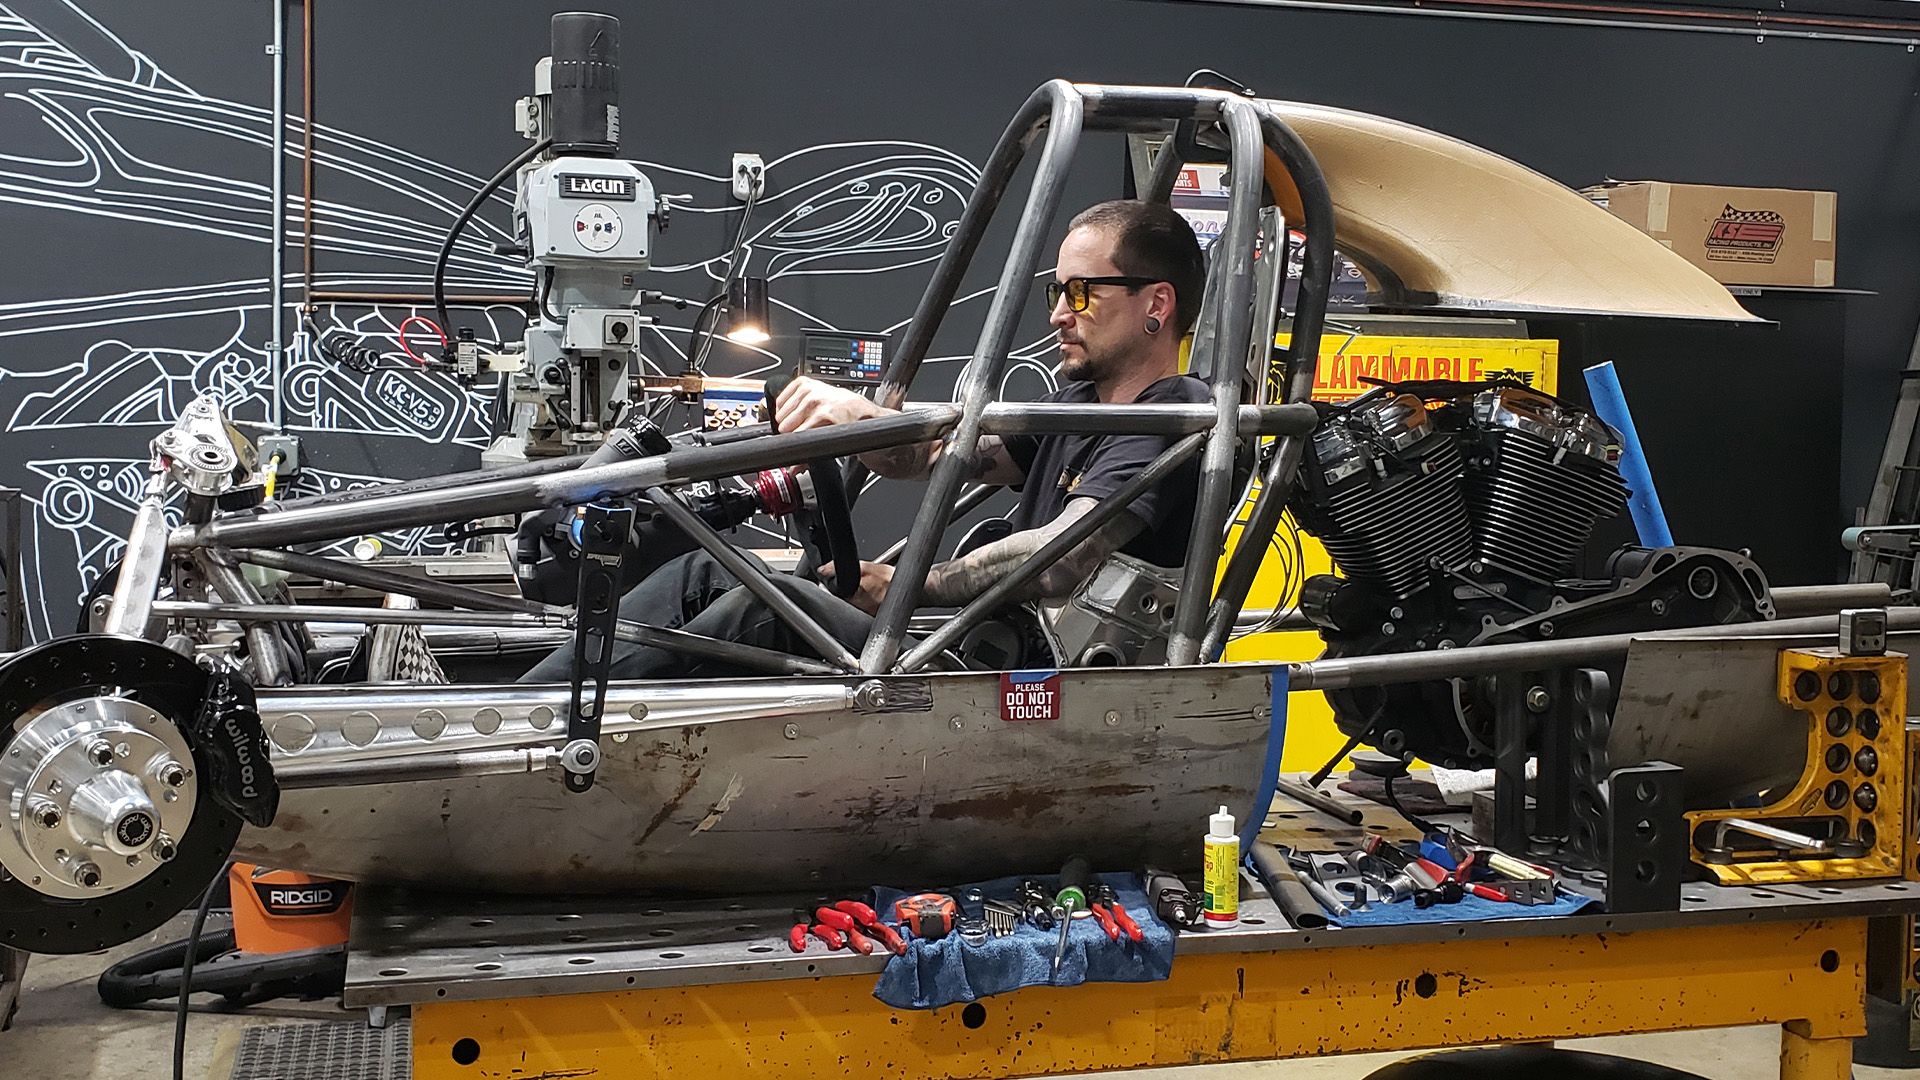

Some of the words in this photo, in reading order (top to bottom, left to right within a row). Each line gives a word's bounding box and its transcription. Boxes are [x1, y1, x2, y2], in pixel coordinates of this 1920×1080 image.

[1174, 179, 1193, 187] ARTS
[1711, 222, 1783, 242] KSE
[1708, 238, 1730, 246] RACING
[1312, 354, 1484, 389] LAMMABLE
[384, 376, 431, 418] KR-V5
[1015, 683, 1046, 692] PLEASE
[1006, 692, 1024, 706] DO
[1028, 691, 1054, 705] NOT
[1007, 705, 1052, 719] TOUCH
[224, 718, 258, 799] wilwood
[270, 889, 333, 905] RIDGID
